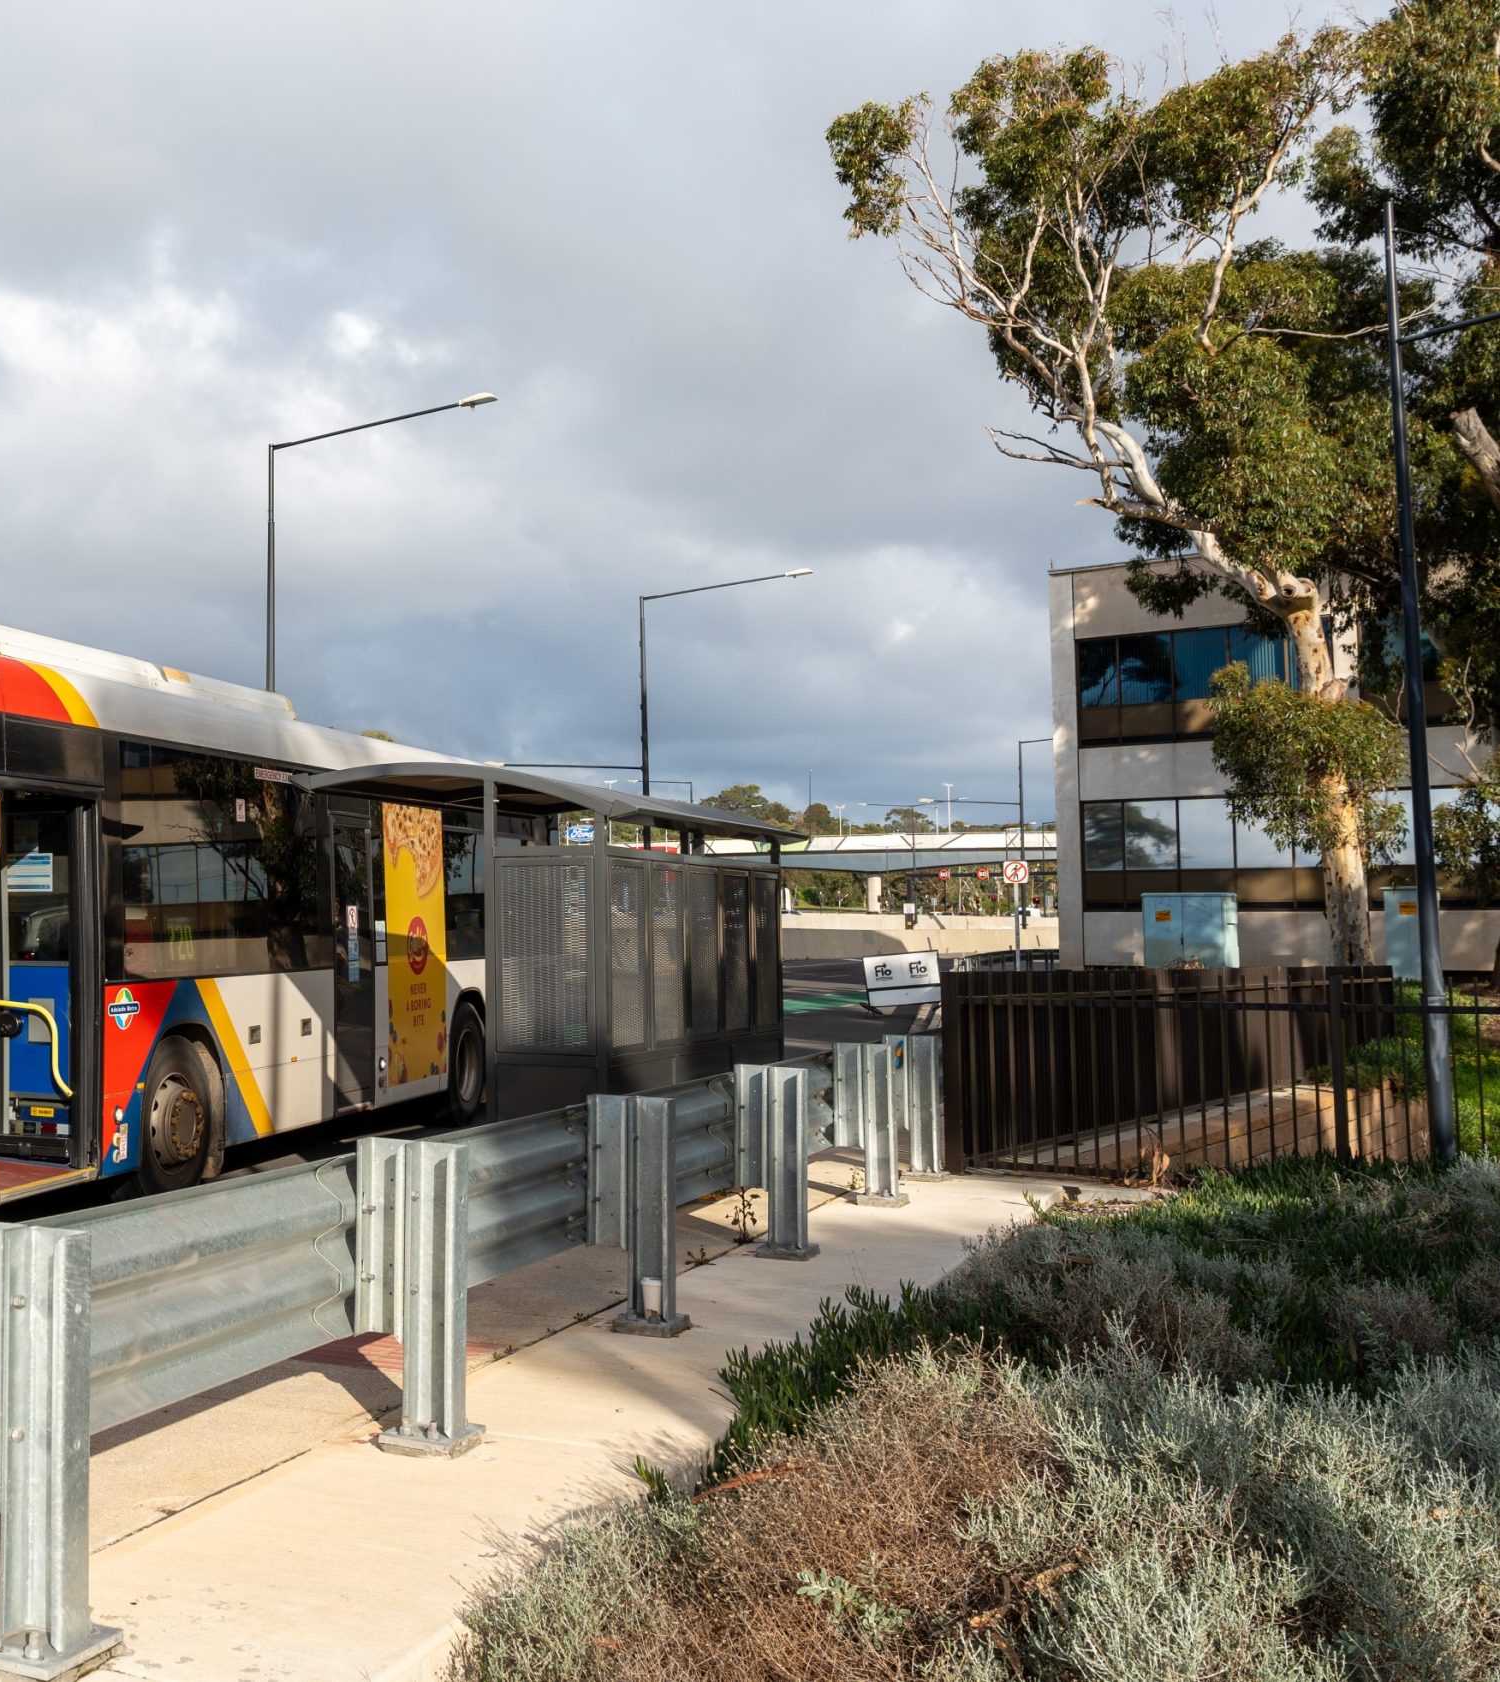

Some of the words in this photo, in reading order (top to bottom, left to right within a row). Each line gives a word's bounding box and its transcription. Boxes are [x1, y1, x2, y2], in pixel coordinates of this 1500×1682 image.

[874, 963, 892, 977] Flo
[909, 960, 927, 975] Flo
[410, 983, 426, 995] NEVER
[406, 1001, 410, 1012] A
[411, 998, 431, 1011] BORING
[413, 1014, 424, 1027] BITE
